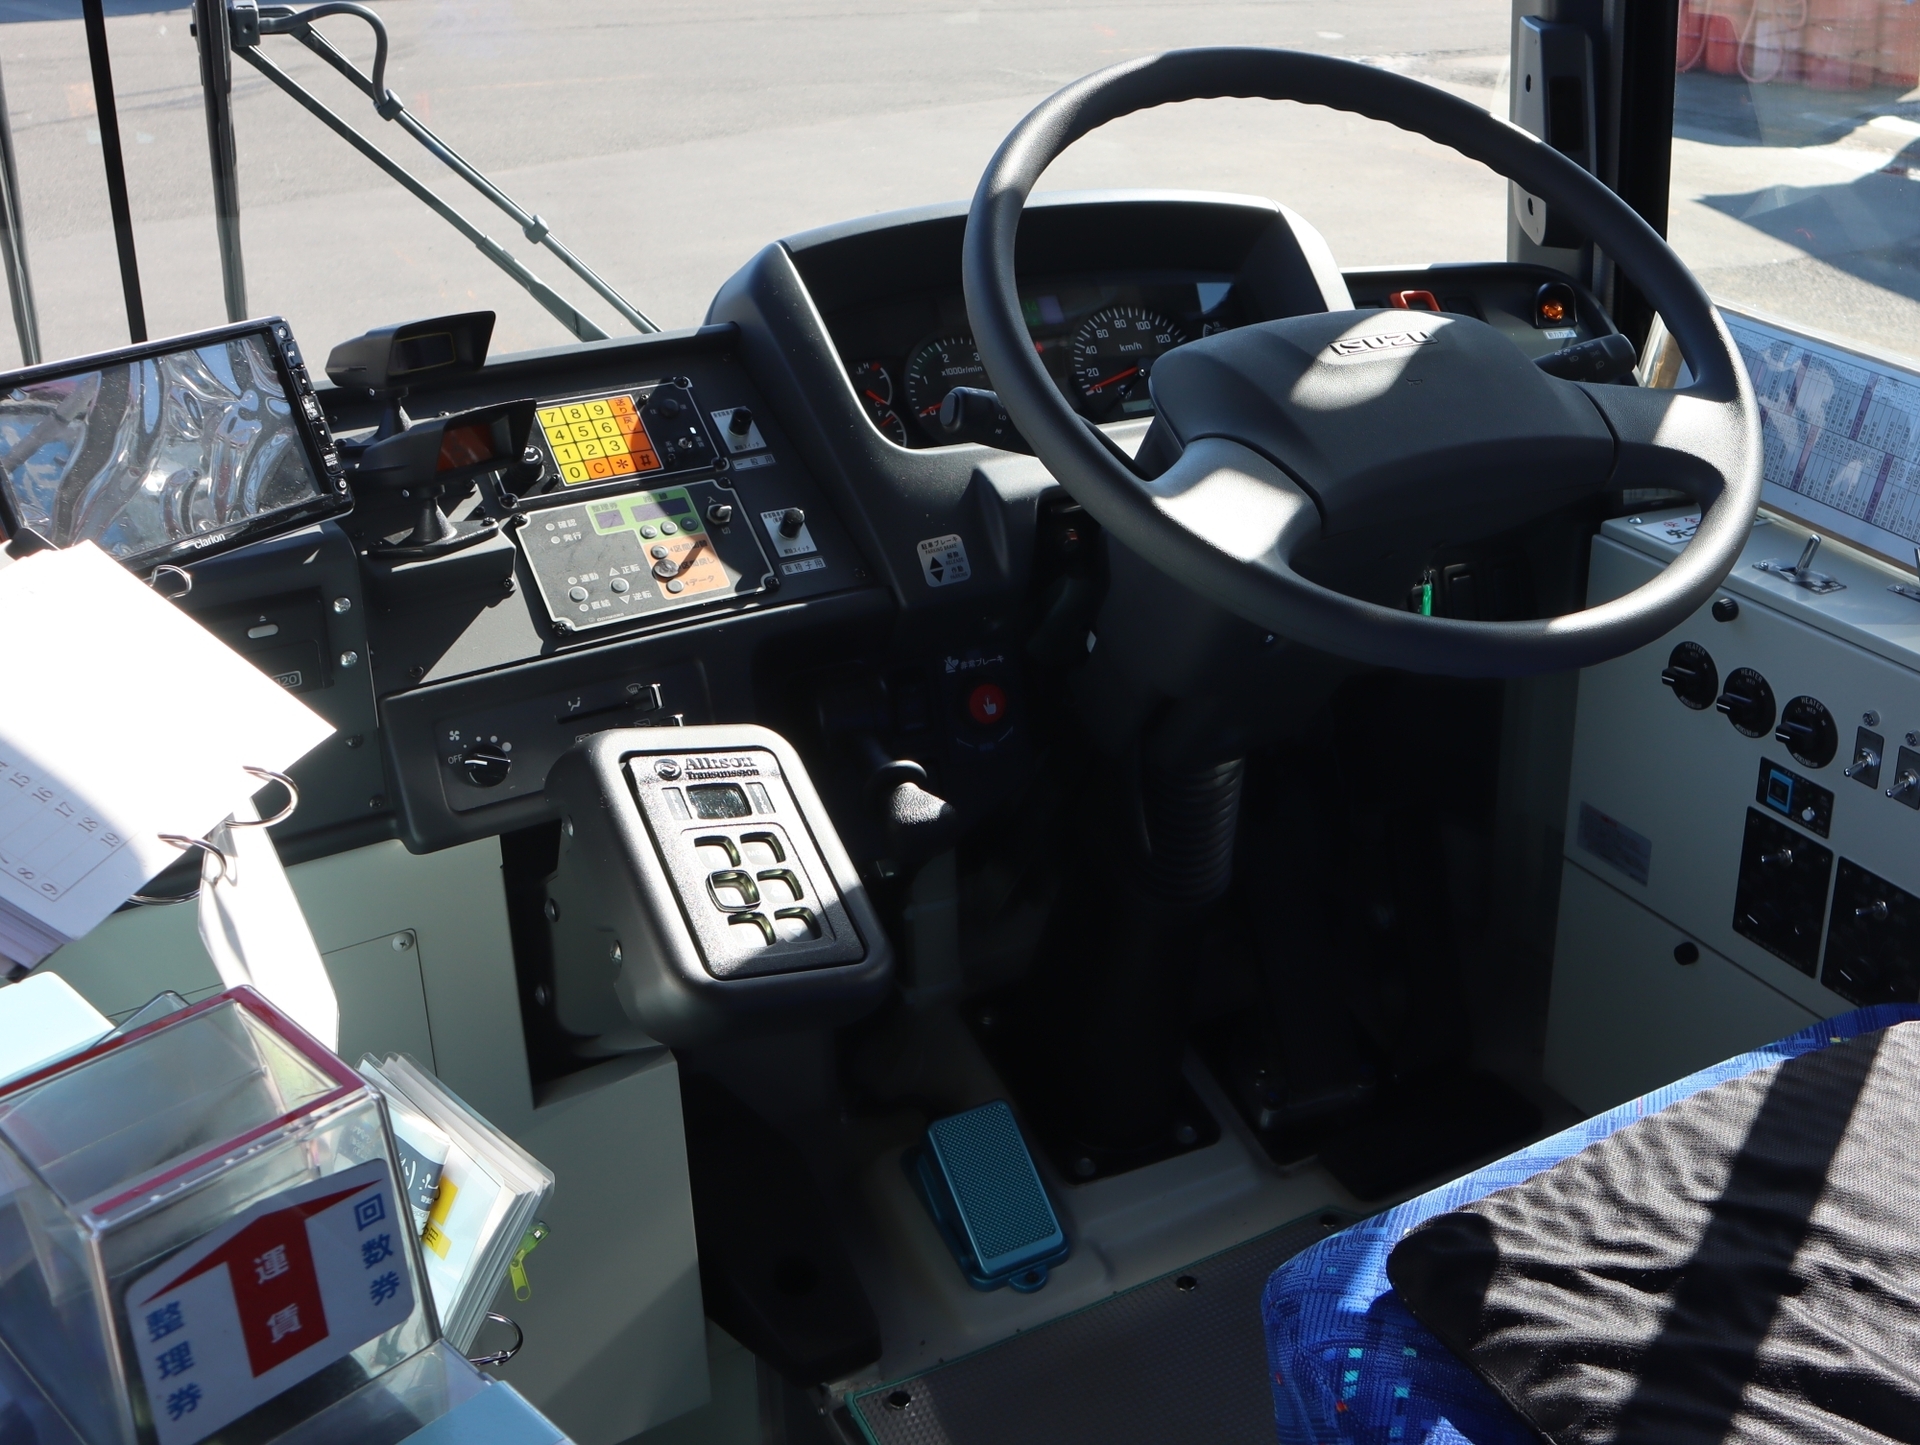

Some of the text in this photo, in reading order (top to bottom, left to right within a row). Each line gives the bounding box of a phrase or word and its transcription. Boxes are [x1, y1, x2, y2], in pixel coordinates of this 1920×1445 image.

[1114, 320, 1127, 329] 80
[1136, 321, 1150, 330] 100
[1096, 329, 1109, 339] 60
[1156, 334, 1171, 343] 120
[1085, 345, 1097, 354] 40
[1120, 342, 1142, 352] km/h
[1328, 330, 1434, 355] ISUZU
[942, 354, 950, 363] 2
[973, 352, 981, 361] 3
[1087, 367, 1099, 377] 20
[546, 405, 604, 423] 7 8 9
[555, 422, 612, 440] 4 5 6
[563, 440, 620, 459] 1 2 3
[1821, 434, 1830, 451] 10:44
[1836, 440, 1845, 457] 10:47
[570, 467, 580, 478] 0
[593, 463, 605, 474] C
[1873, 454, 1883, 472] 10:54
[1888, 460, 1898, 478] 10:56
[1896, 463, 1906, 481] 10:57
[621, 564, 641, 574] 正転
[960, 654, 1004, 670] 非常ブレーキ
[1740, 668, 1763, 683] HEATER
[1800, 697, 1824, 712] HEATER
[447, 754, 462, 765] OFF
[684, 757, 757, 771] Allison
[9, 772, 31, 789] 15
[32, 787, 53, 803] 16
[55, 801, 75, 819] 17
[78, 816, 99, 833] 18
[100, 832, 120, 848] 19
[17, 867, 36, 880] 8
[41, 882, 58, 895] 9
[354, 1193, 402, 1308] 回数券
[253, 1243, 303, 1344] 運賃
[145, 1301, 203, 1423] 整理券
